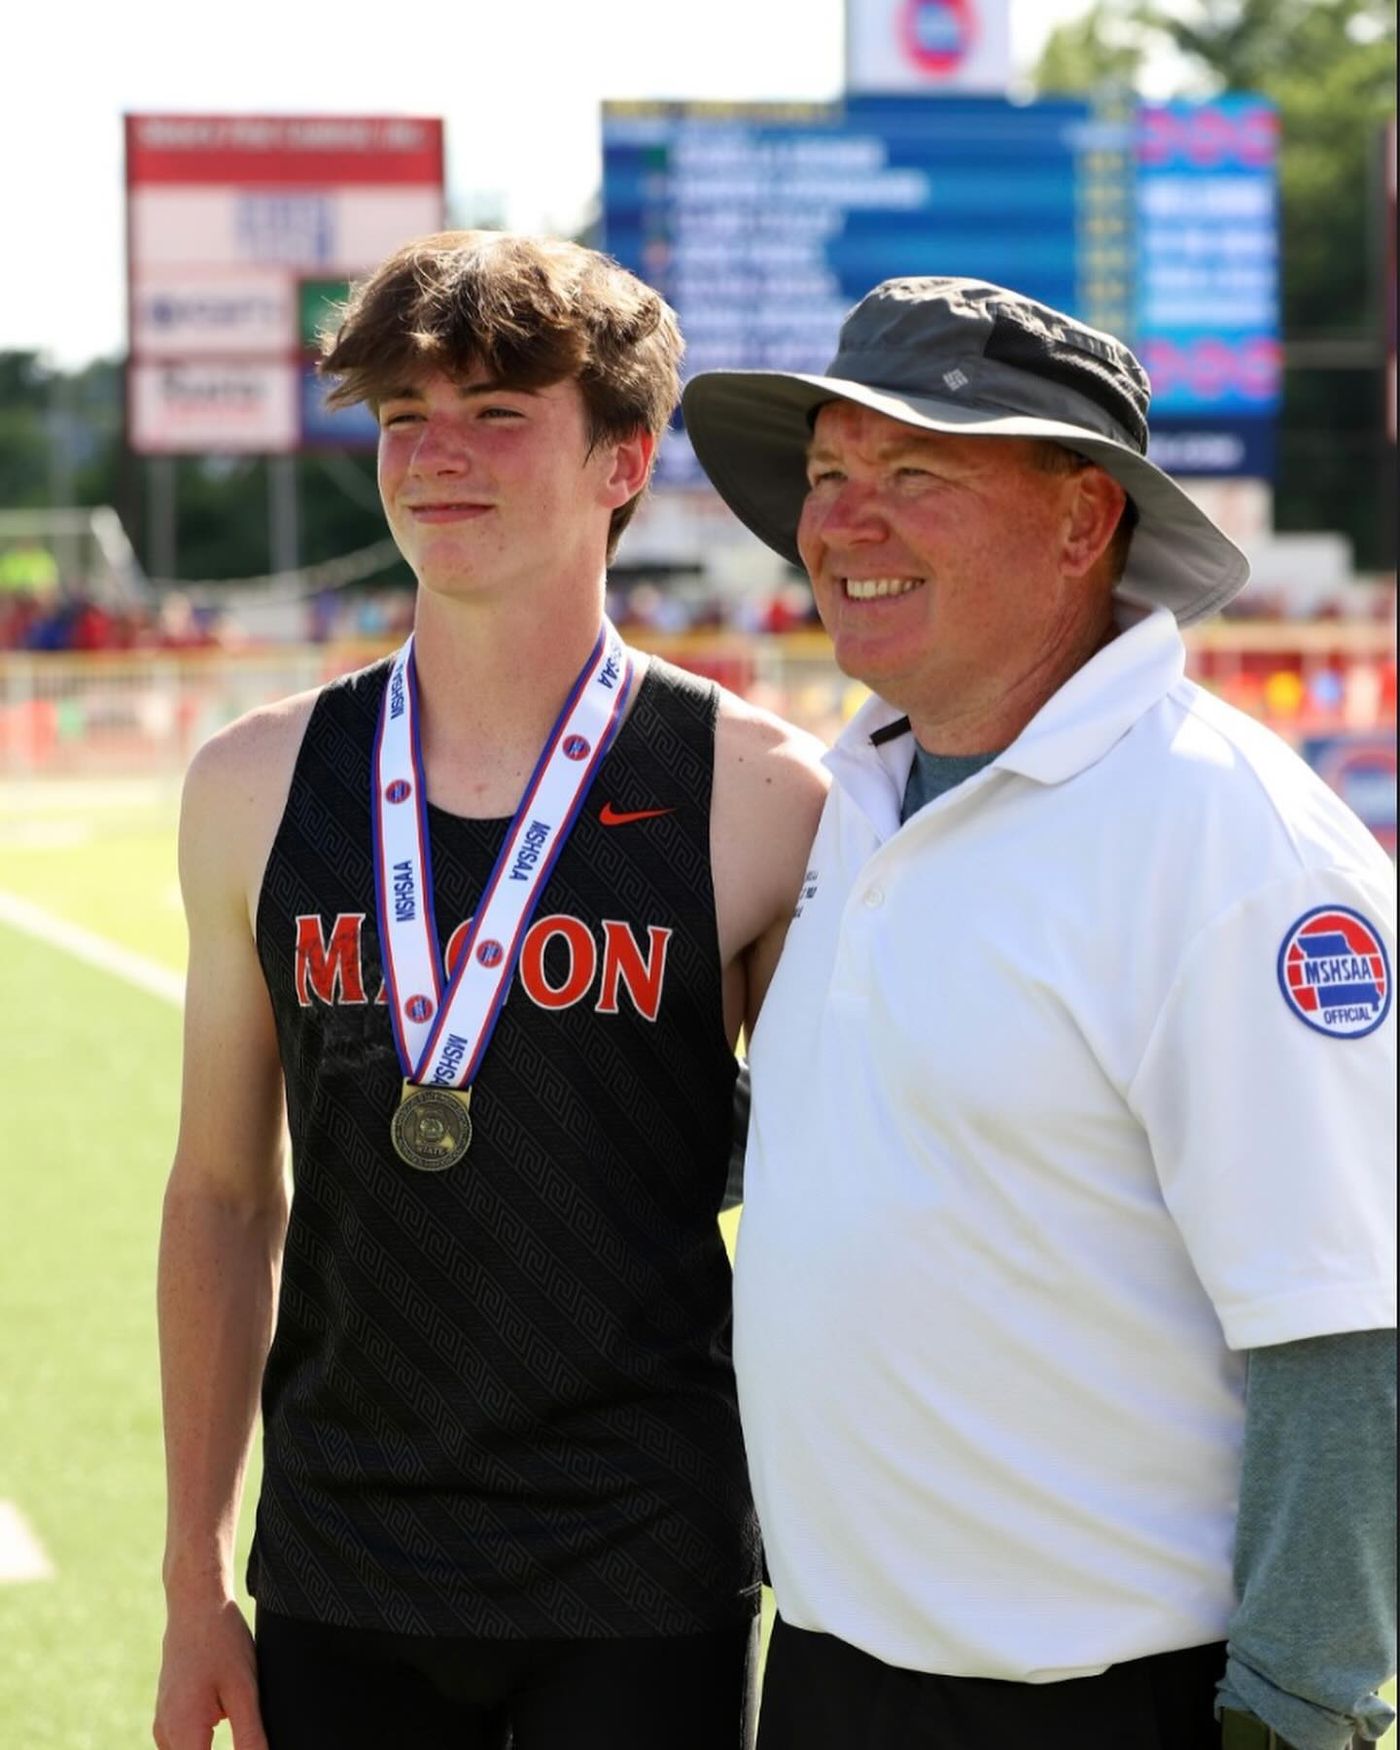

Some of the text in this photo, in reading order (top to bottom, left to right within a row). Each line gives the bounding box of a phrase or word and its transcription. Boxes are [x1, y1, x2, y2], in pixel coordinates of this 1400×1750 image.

[597, 639, 622, 689] SAA
[509, 820, 551, 881] MSHSAA
[393, 860, 415, 922] MSHSAA
[295, 913, 673, 1022] MON
[1304, 956, 1373, 985] MSHSAA
[1323, 1006, 1372, 1025] OFFICIAL
[430, 1033, 468, 1086] MSHSA
